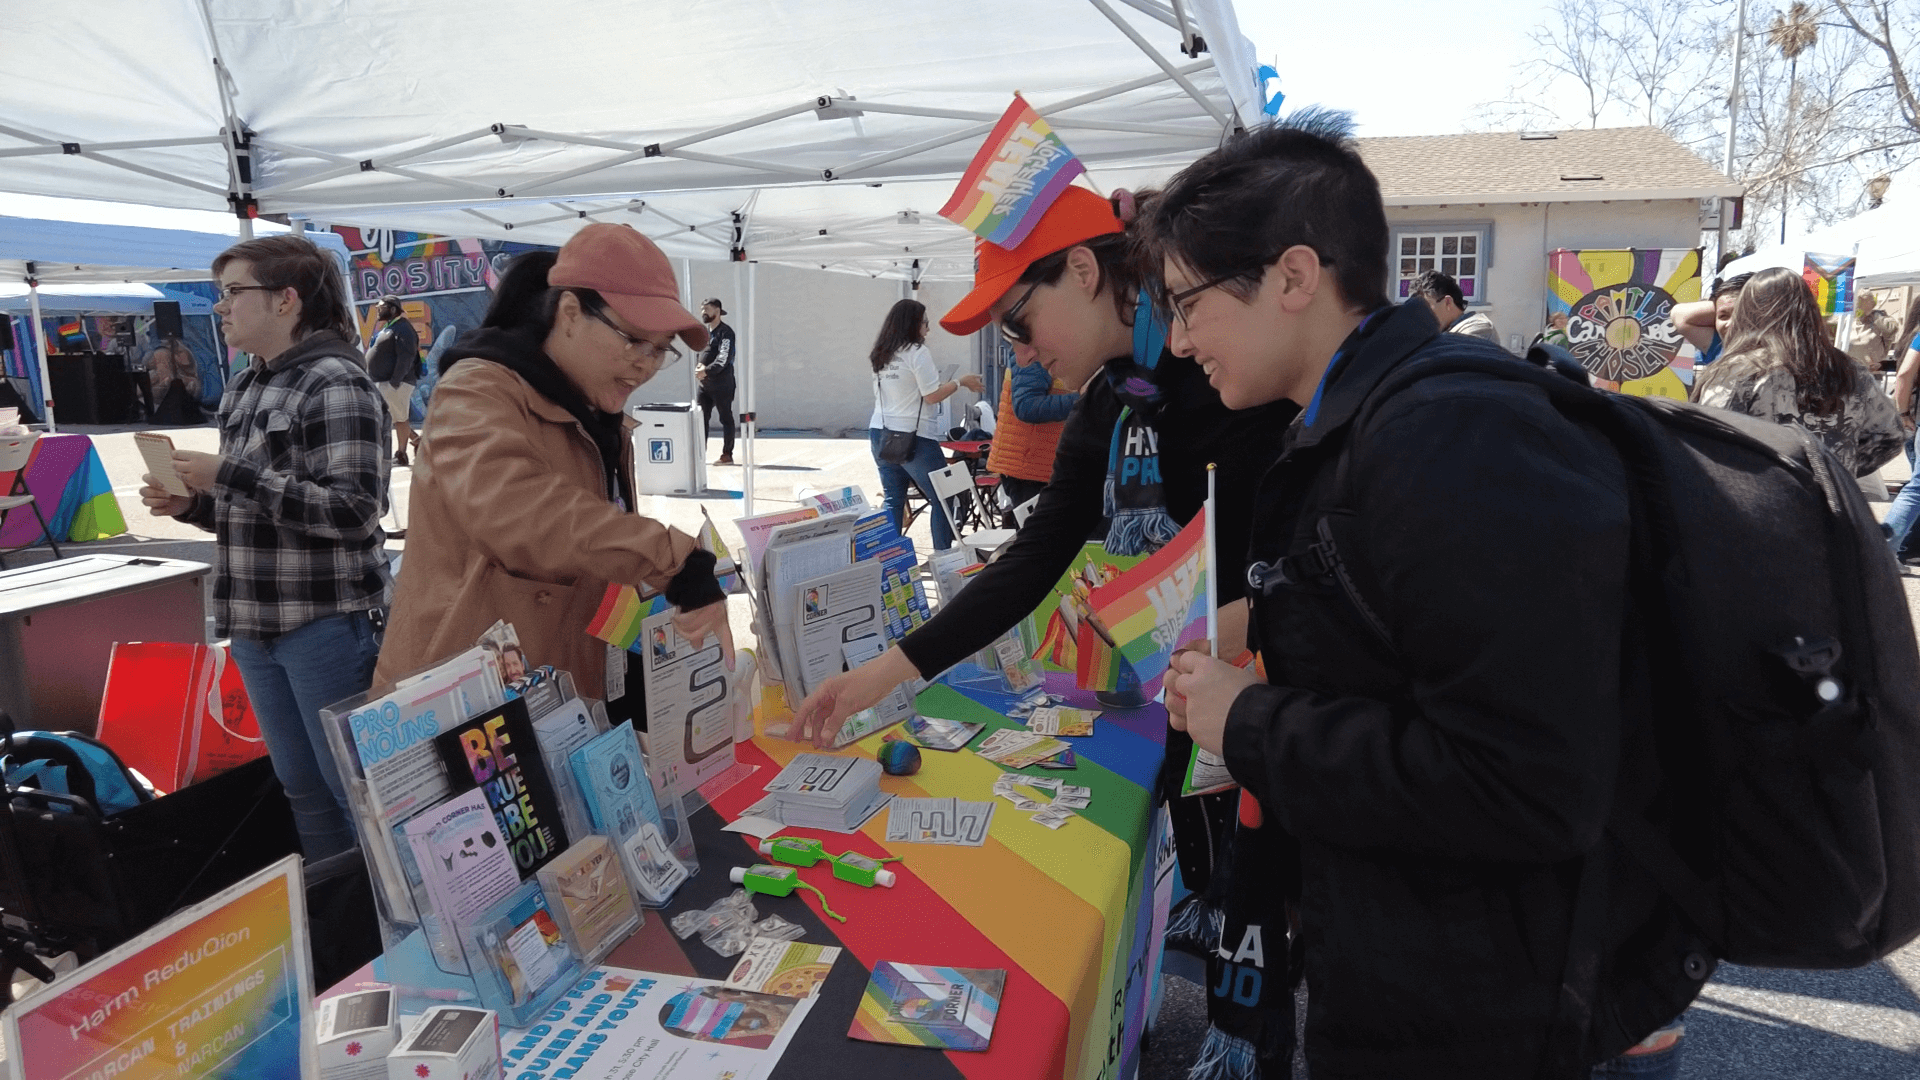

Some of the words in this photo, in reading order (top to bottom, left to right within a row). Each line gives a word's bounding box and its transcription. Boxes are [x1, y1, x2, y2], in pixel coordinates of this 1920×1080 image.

[1569, 338, 1677, 381] CHOSEN
[806, 608, 828, 621] CORNER
[654, 650, 676, 666] CORNER
[350, 701, 400, 742] PRO
[357, 710, 440, 768] NOUNS
[459, 715, 517, 784] BE
[484, 766, 526, 809] RUE
[503, 794, 538, 838] BE
[510, 827, 548, 869] OU
[69, 985, 138, 1041] Harm
[543, 999, 572, 1022] UP
[566, 969, 607, 999] FOR
[579, 993, 612, 1028] AND
[596, 977, 658, 1031] YOUTH
[176, 1022, 245, 1077] NARCAN
[618, 1047, 635, 1064] 5:30
[633, 1035, 646, 1048] pm
[632, 1052, 650, 1068] City
[644, 1038, 660, 1052] Hall
